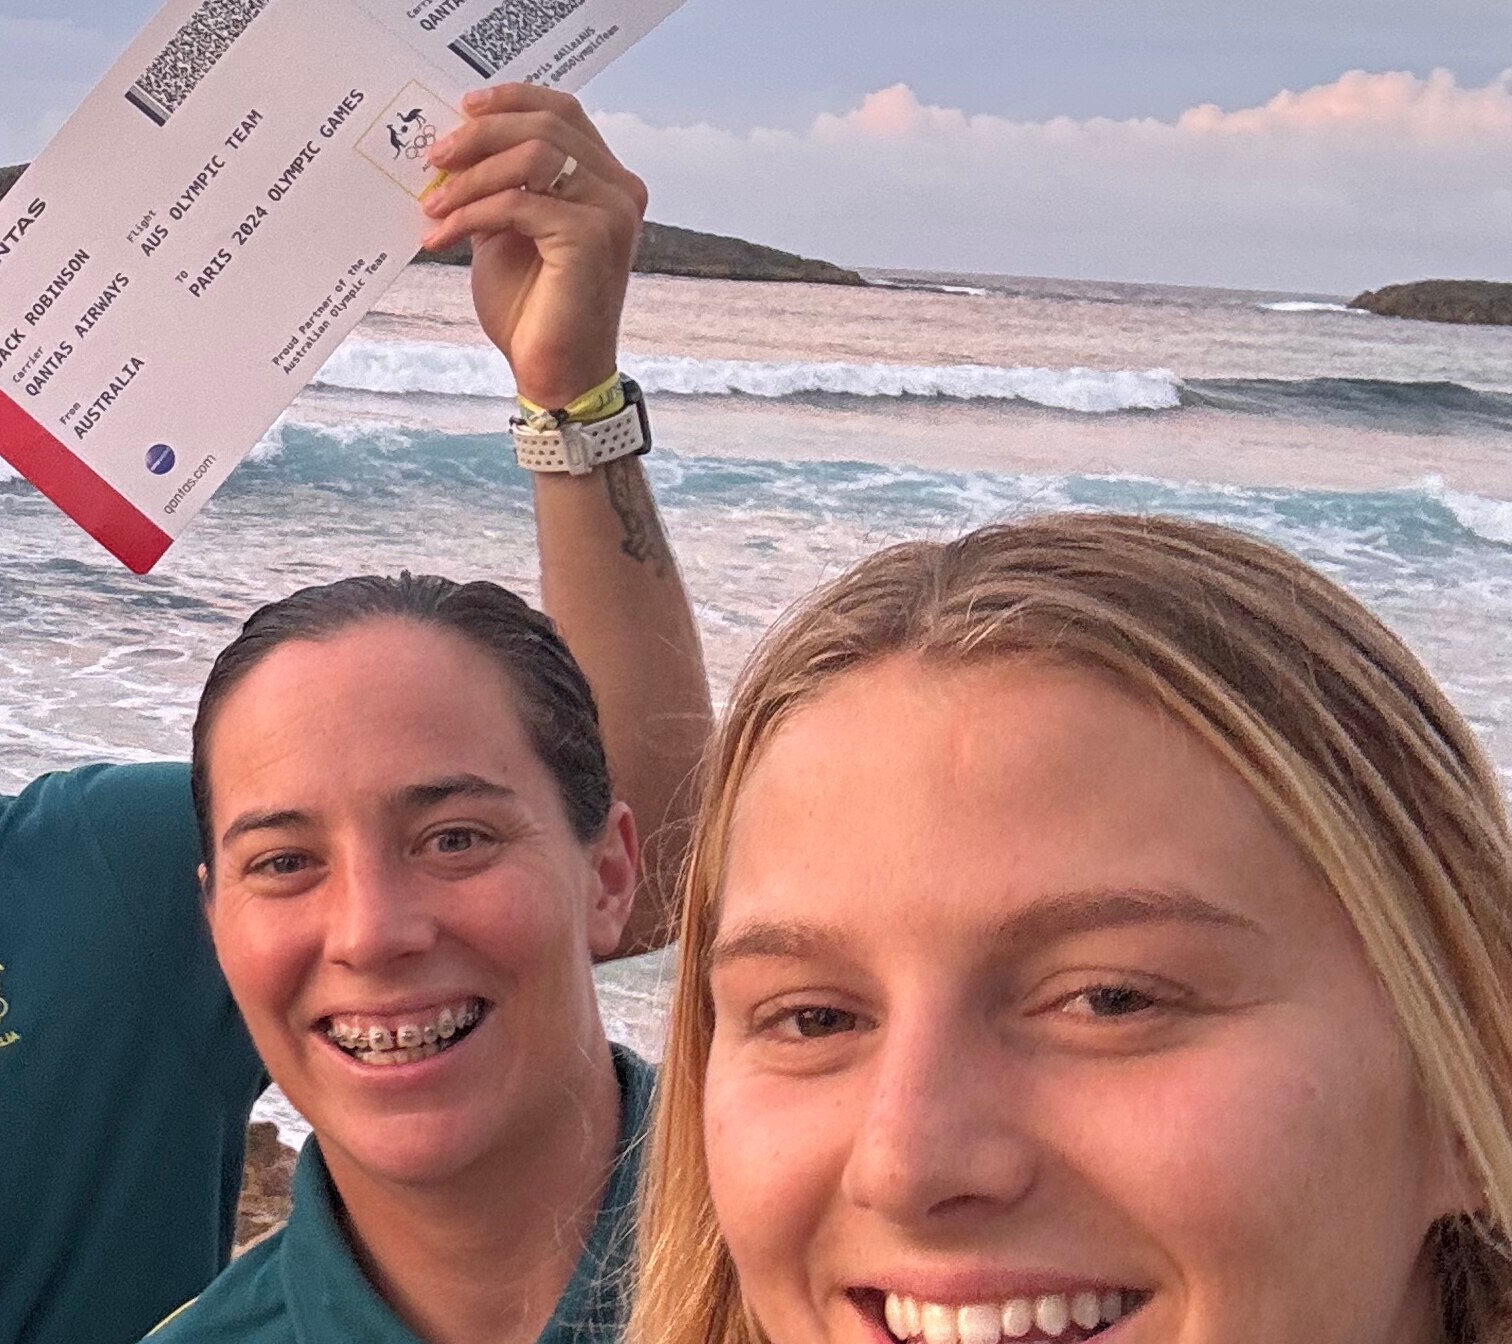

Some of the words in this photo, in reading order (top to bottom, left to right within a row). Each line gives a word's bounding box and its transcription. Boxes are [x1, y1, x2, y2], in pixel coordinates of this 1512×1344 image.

[140, 224, 169, 258] AUS
[169, 154, 226, 221] OLYMPIC
[224, 109, 264, 150] TEAM
[188, 248, 233, 298] PARIS
[231, 205, 269, 246] 2024
[267, 140, 322, 202] OLYMPIC
[319, 88, 365, 139] GAMES
[125, 209, 157, 244] Flight
[23, 248, 91, 327] ROBINSON
[270, 335, 300, 367] Proud
[298, 294, 333, 335] Partner
[334, 278, 347, 293] of
[347, 258, 366, 276] the
[282, 320, 331, 376] Australian
[329, 278, 366, 318] Olympic
[364, 252, 388, 275] Team
[12, 346, 44, 384] Carrier
[24, 340, 74, 397] QANTAS
[74, 272, 130, 339] AIRWAYS
[58, 402, 82, 426] From
[73, 356, 146, 440] AUSTRALIA
[163, 454, 217, 515] qantas.com
